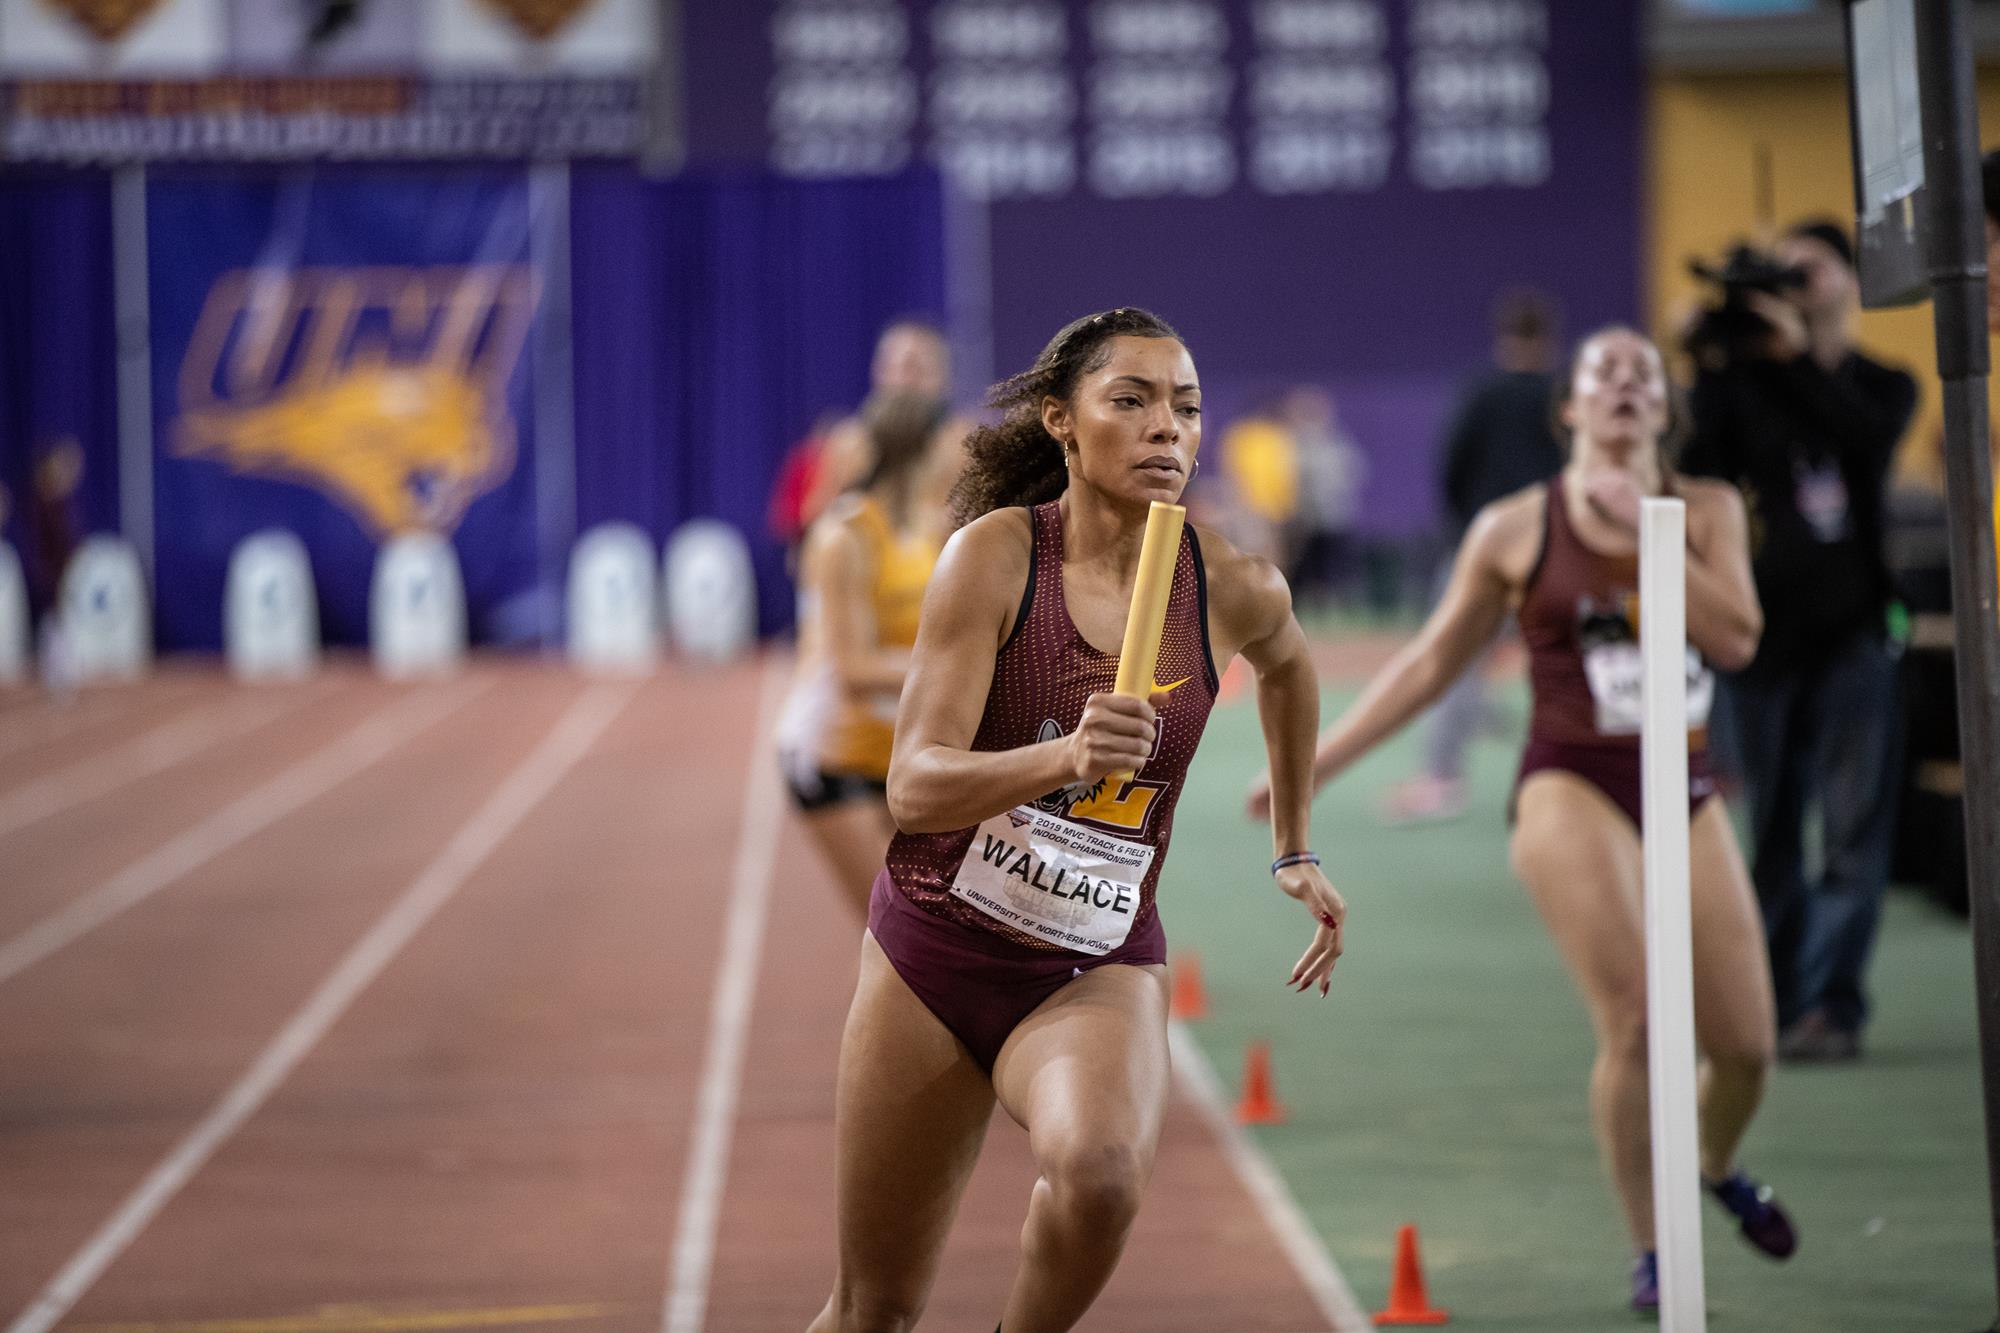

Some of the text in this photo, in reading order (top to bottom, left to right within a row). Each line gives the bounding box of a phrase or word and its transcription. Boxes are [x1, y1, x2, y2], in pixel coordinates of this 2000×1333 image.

[1031, 828, 1142, 867] INDOOR CHAMPIONSHIPS
[1036, 818, 1146, 857] 2019 MVC TRACK & FIELD
[981, 834, 1131, 914] WALLACE
[966, 889, 1110, 951] UNIVERSITY OF NORTHERN IOWA
